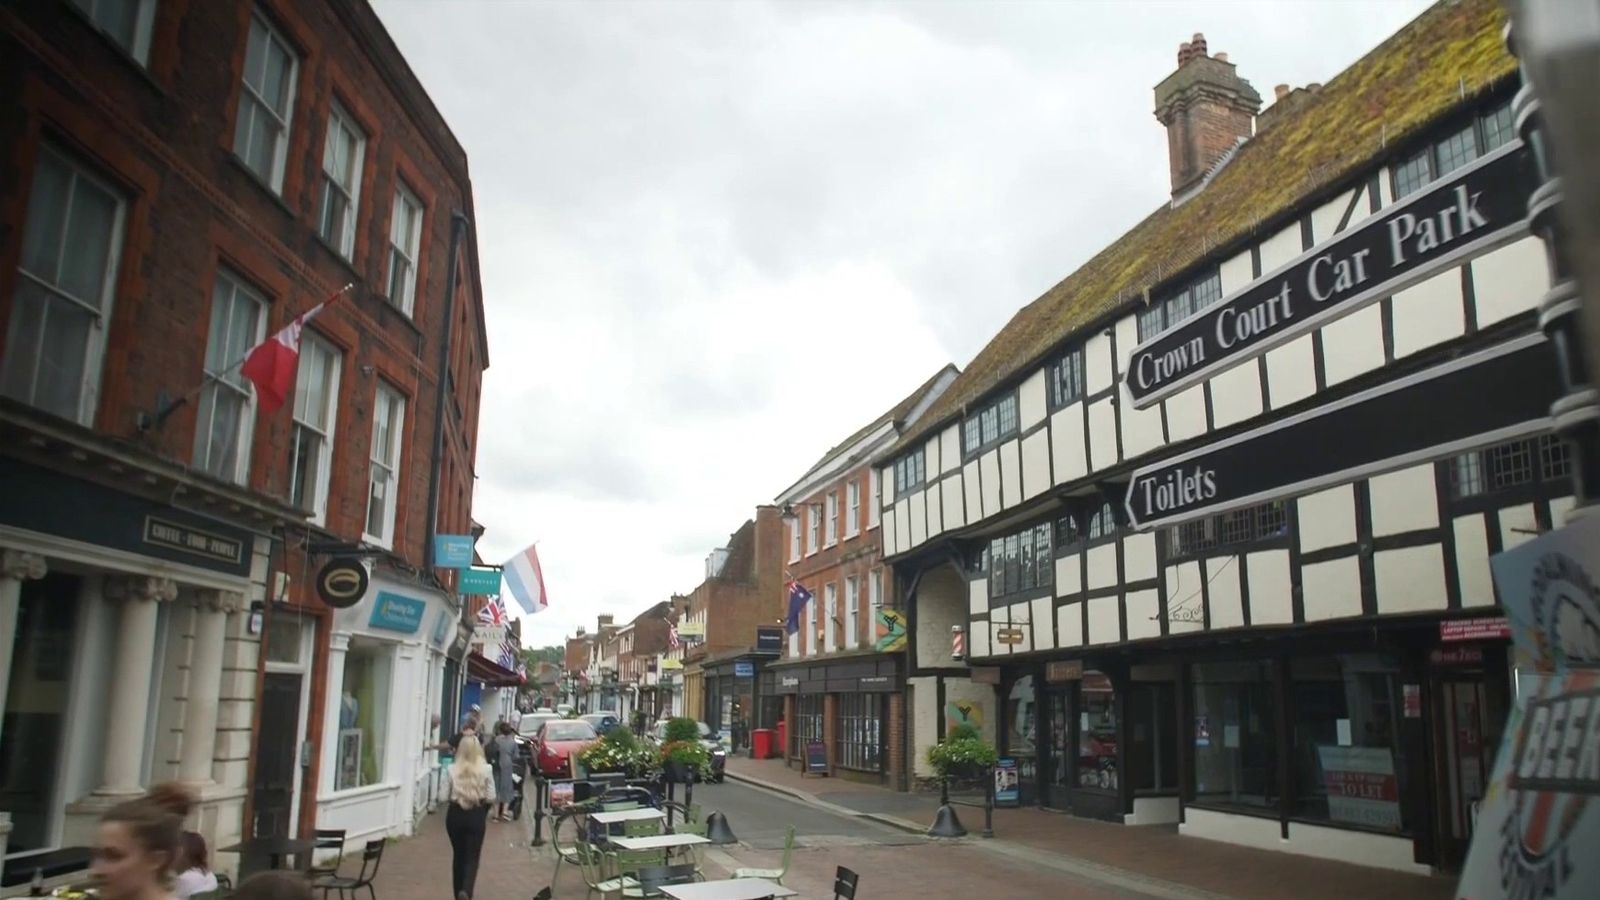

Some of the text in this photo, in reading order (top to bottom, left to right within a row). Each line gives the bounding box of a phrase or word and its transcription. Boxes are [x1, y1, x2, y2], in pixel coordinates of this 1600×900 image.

[1135, 184, 1491, 390] Crown Court Car Park
[1139, 464, 1217, 517] Toilets
